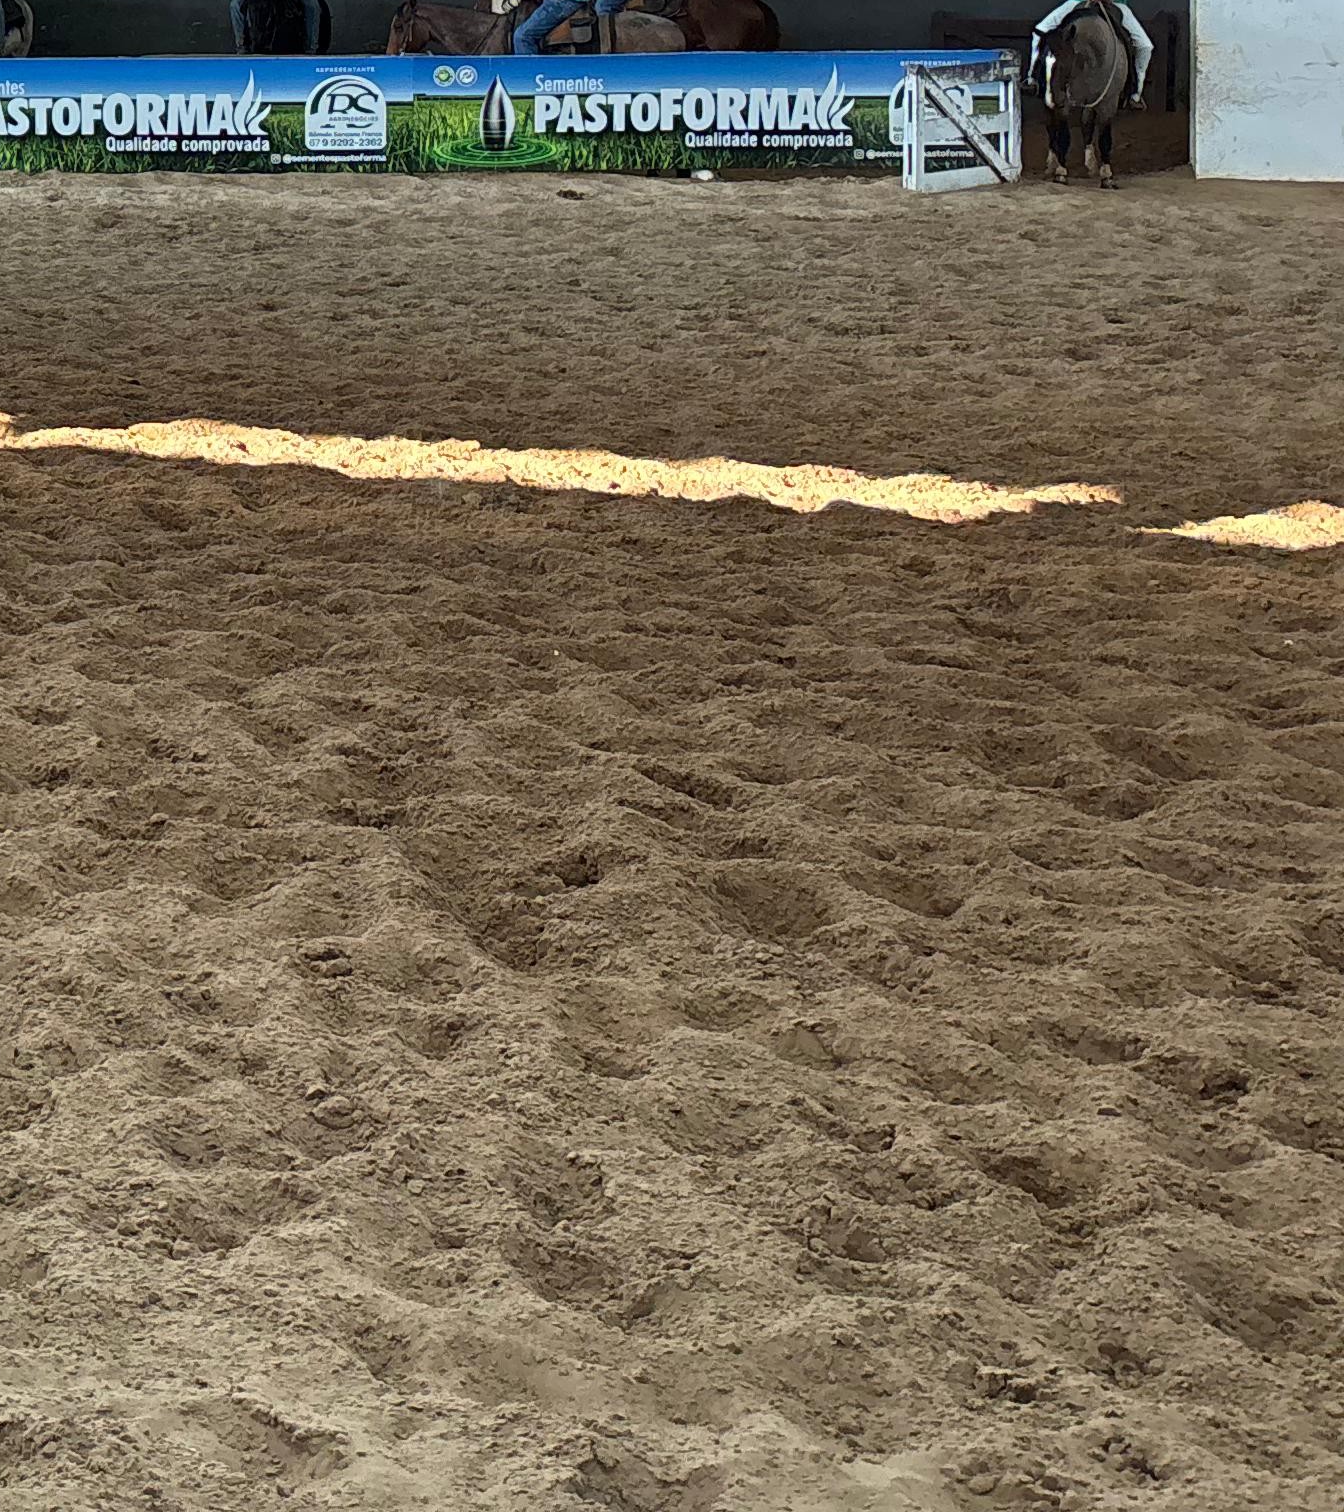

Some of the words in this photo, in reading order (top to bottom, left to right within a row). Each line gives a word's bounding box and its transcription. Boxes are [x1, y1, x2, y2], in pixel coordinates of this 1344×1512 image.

[535, 74, 604, 92] Sementes
[534, 87, 818, 133] PASTOFORMA
[105, 136, 177, 152] Qualidade
[181, 135, 270, 154] comprovada
[684, 132, 758, 148] Qualidade
[761, 131, 853, 150] comprovada
